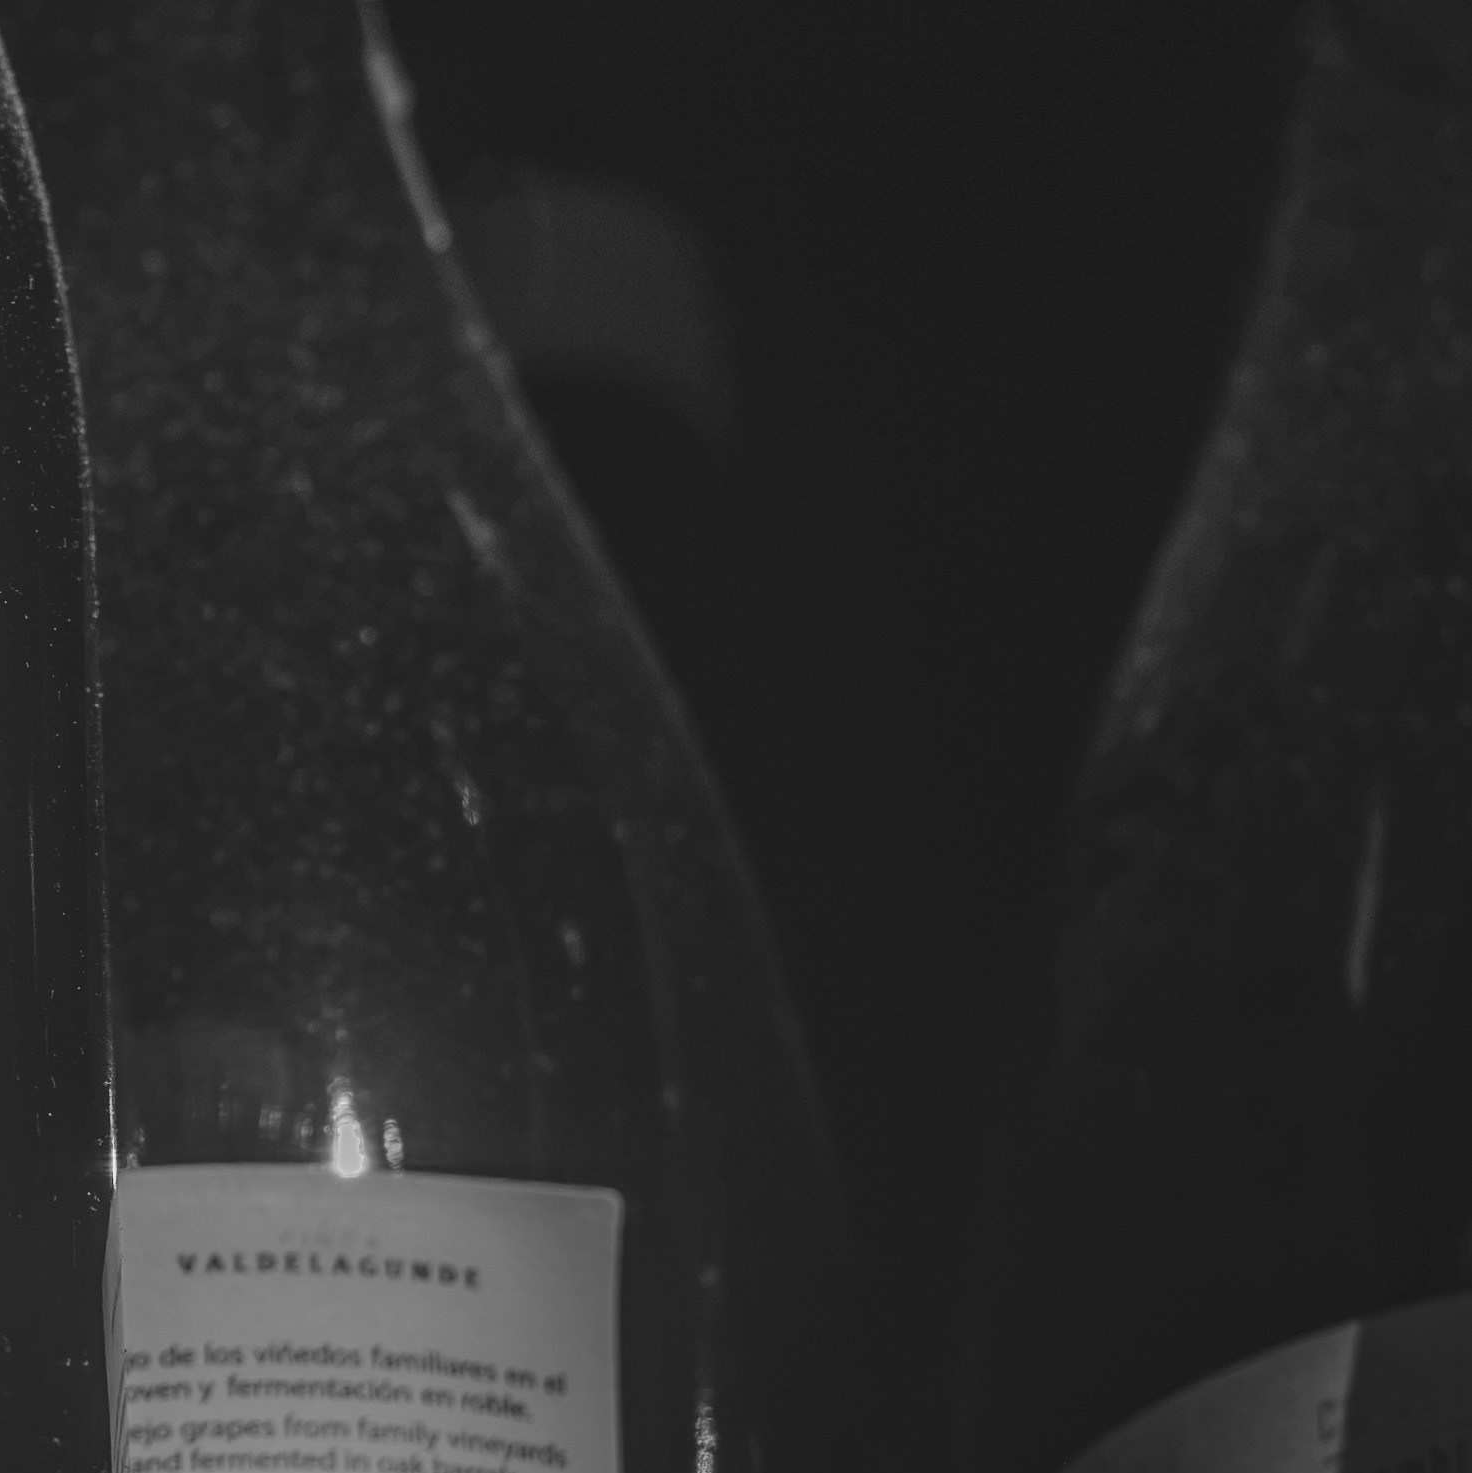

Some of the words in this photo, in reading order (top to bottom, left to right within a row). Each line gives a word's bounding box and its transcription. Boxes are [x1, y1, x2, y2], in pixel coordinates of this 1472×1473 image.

[177, 1252, 479, 1288] VALDELAGUNDE
[157, 1344, 194, 1368] de
[204, 1343, 244, 1366] los
[254, 1343, 362, 1368] viñedos
[370, 1344, 497, 1384] familiares
[504, 1367, 537, 1390] en
[544, 1372, 568, 1397] el
[198, 1383, 215, 1403] y
[227, 1373, 412, 1403] fermentación
[421, 1387, 455, 1408] en
[179, 1420, 275, 1444] grapes
[283, 1413, 350, 1439] from
[357, 1417, 439, 1451] family
[446, 1431, 568, 1470] vineyards
[132, 1451, 182, 1472] and
[190, 1447, 336, 1473] fermented
[345, 1452, 371, 1472] in
